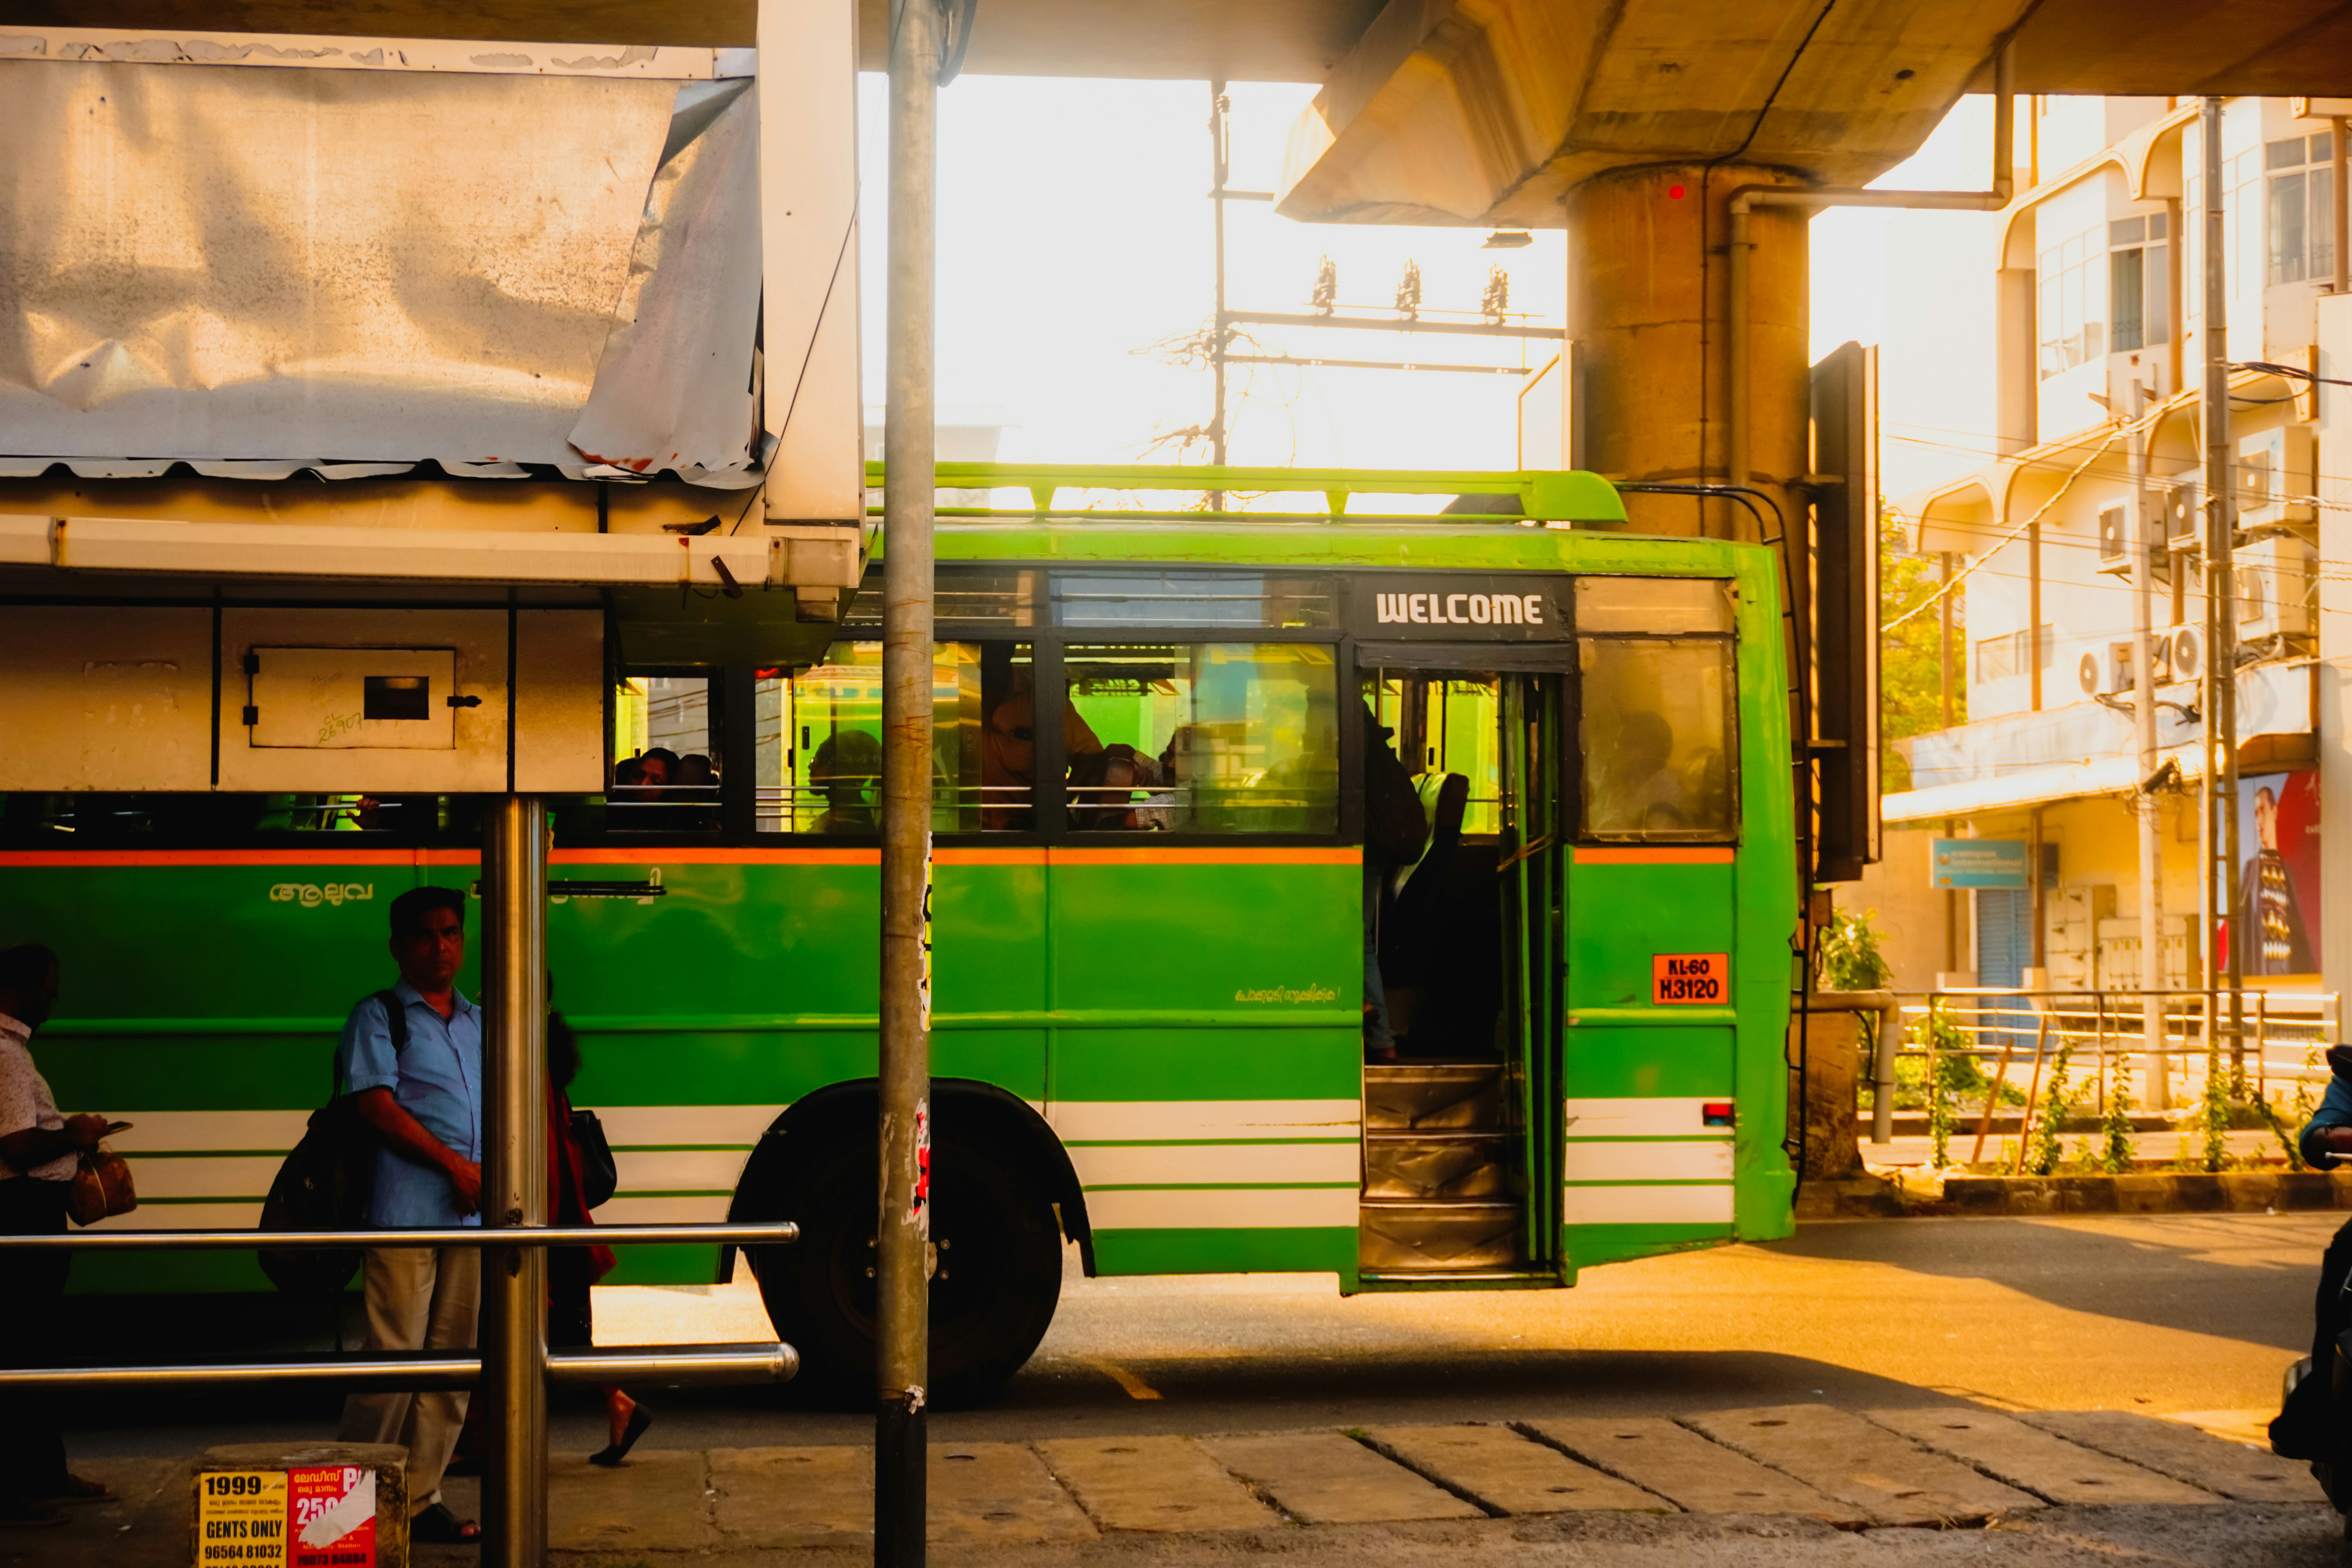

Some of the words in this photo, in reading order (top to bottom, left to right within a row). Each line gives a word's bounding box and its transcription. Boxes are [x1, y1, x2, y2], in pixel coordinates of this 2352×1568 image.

[1377, 593, 1543, 624] WELCOME
[319, 712, 362, 744] 26907
[269, 883, 373, 908] ആലുവ
[205, 1475, 261, 1495] 1999
[294, 1469, 342, 1483] ലേഡീസ്
[298, 1486, 313, 1495] ഒരു
[207, 1521, 248, 1539] GENTS
[251, 1520, 282, 1538] ONLY
[205, 1545, 243, 1559] 96564
[246, 1544, 282, 1559] 81032
